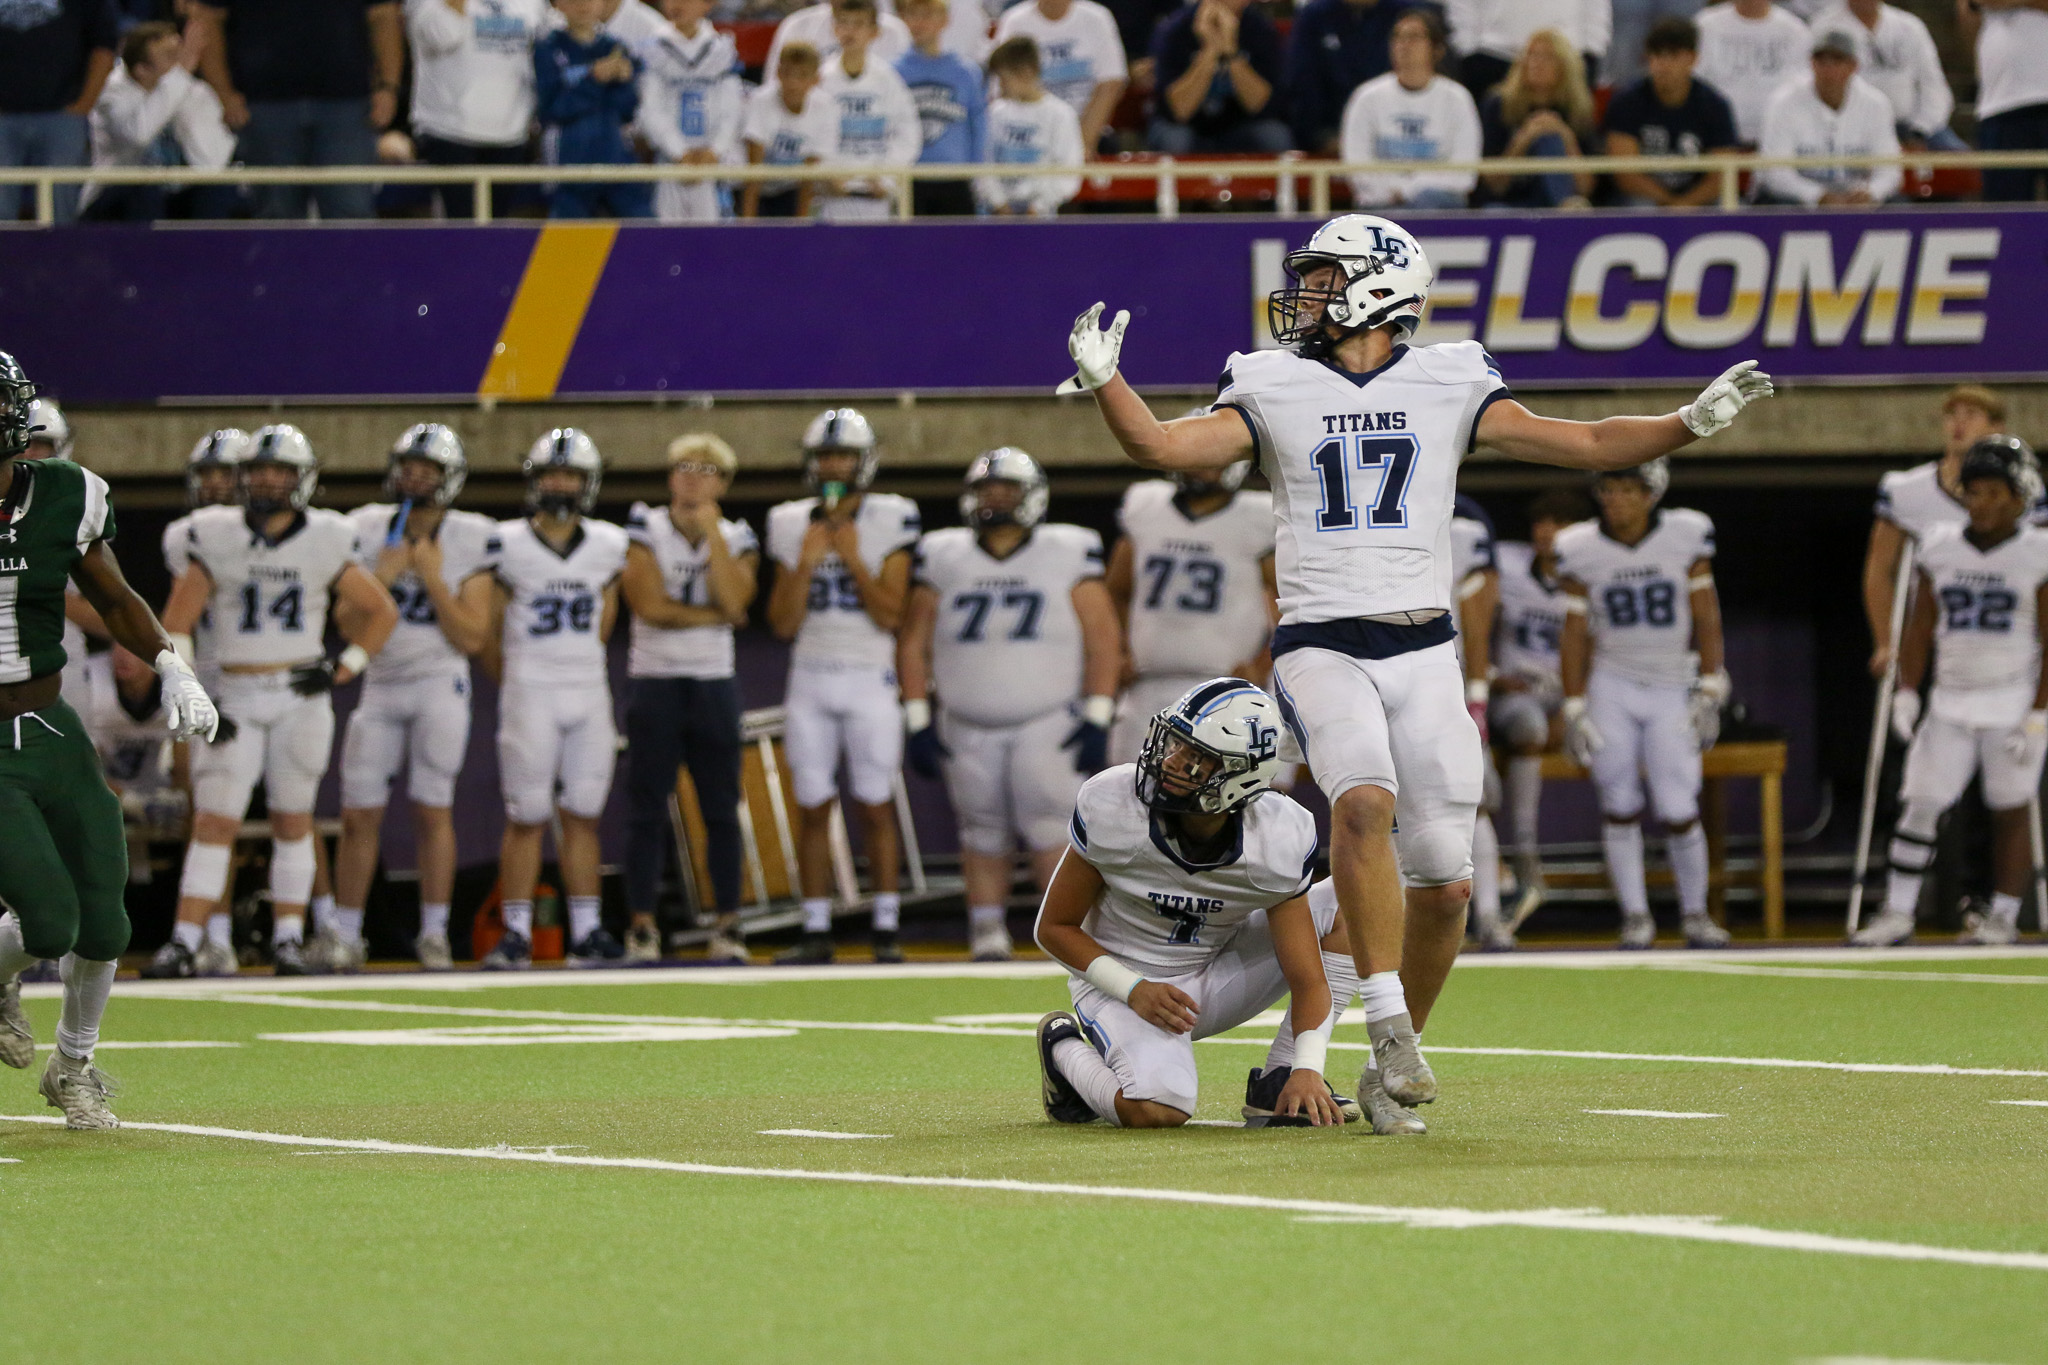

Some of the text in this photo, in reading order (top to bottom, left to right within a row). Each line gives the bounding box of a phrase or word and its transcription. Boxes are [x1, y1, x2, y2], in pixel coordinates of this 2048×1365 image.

[1364, 225, 1409, 271] LC
[1252, 227, 2000, 352] ELCOME
[1323, 411, 1407, 433] TITANS
[1310, 433, 1421, 532] 17
[1143, 557, 1226, 613] 73
[1605, 581, 1677, 627] 88
[240, 583, 305, 634] 14
[953, 590, 1044, 642] 77
[1941, 586, 2016, 632] 22
[1148, 891, 1224, 914] TITANS
[1156, 901, 1207, 944] 7
